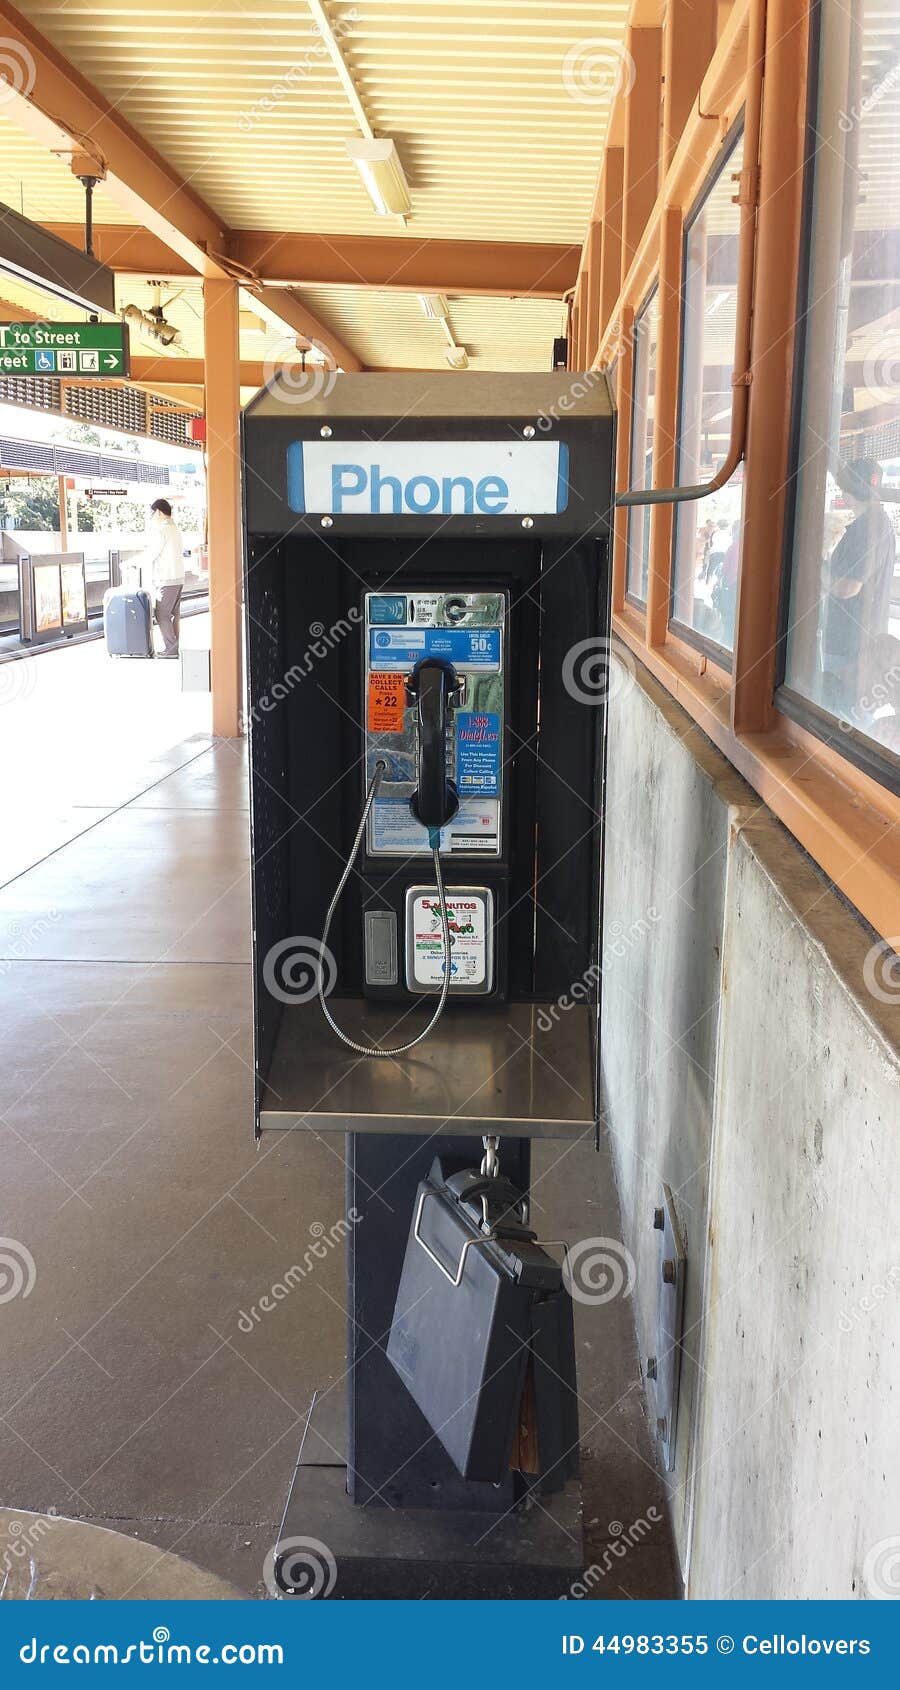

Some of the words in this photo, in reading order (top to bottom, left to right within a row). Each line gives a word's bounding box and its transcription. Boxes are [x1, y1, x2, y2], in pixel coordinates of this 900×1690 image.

[14, 332, 31, 344] to
[35, 330, 81, 344] Street
[331, 463, 509, 514] Phone
[422, 900, 430, 909] 5
